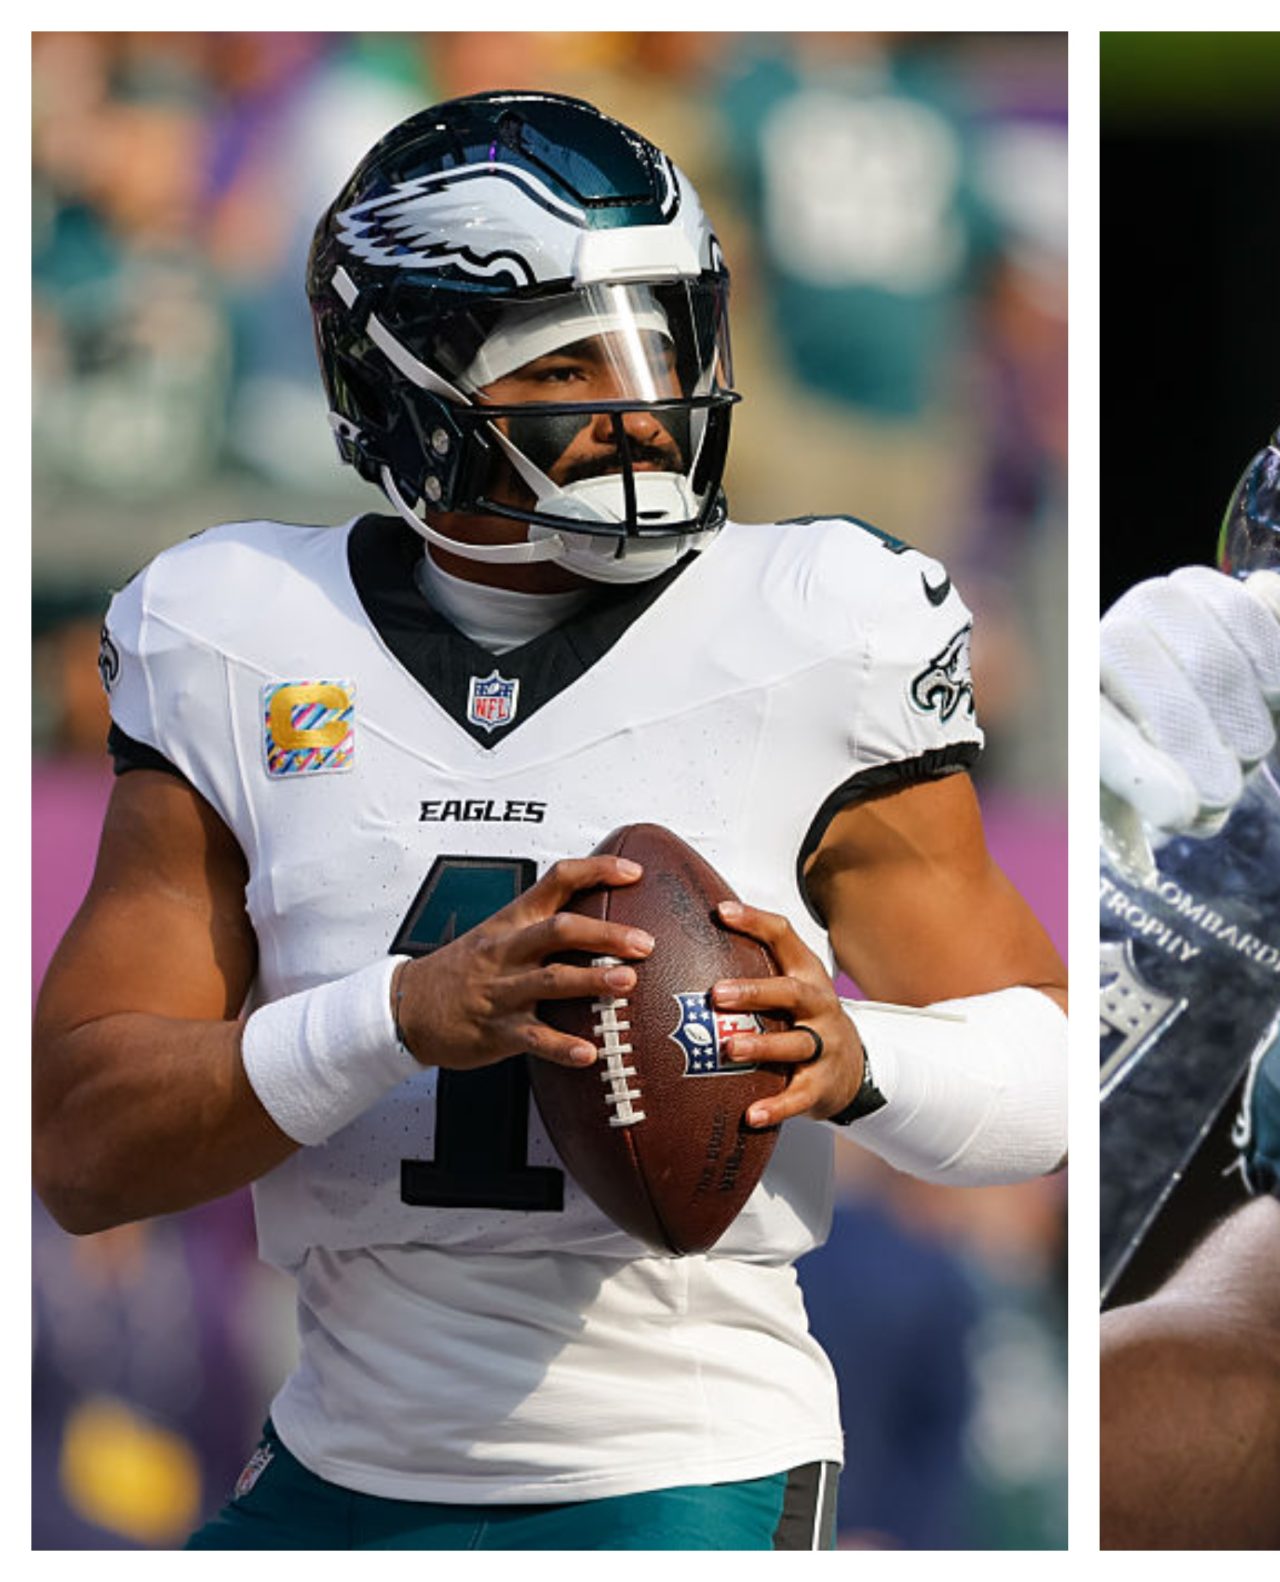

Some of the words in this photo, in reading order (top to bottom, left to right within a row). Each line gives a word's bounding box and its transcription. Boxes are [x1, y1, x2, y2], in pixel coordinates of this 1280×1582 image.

[270, 685, 348, 751] C
[475, 697, 507, 720] NFL
[418, 800, 548, 823] EAGLES
[1099, 876, 1200, 962] TROPHY
[388, 854, 565, 1212] 1
